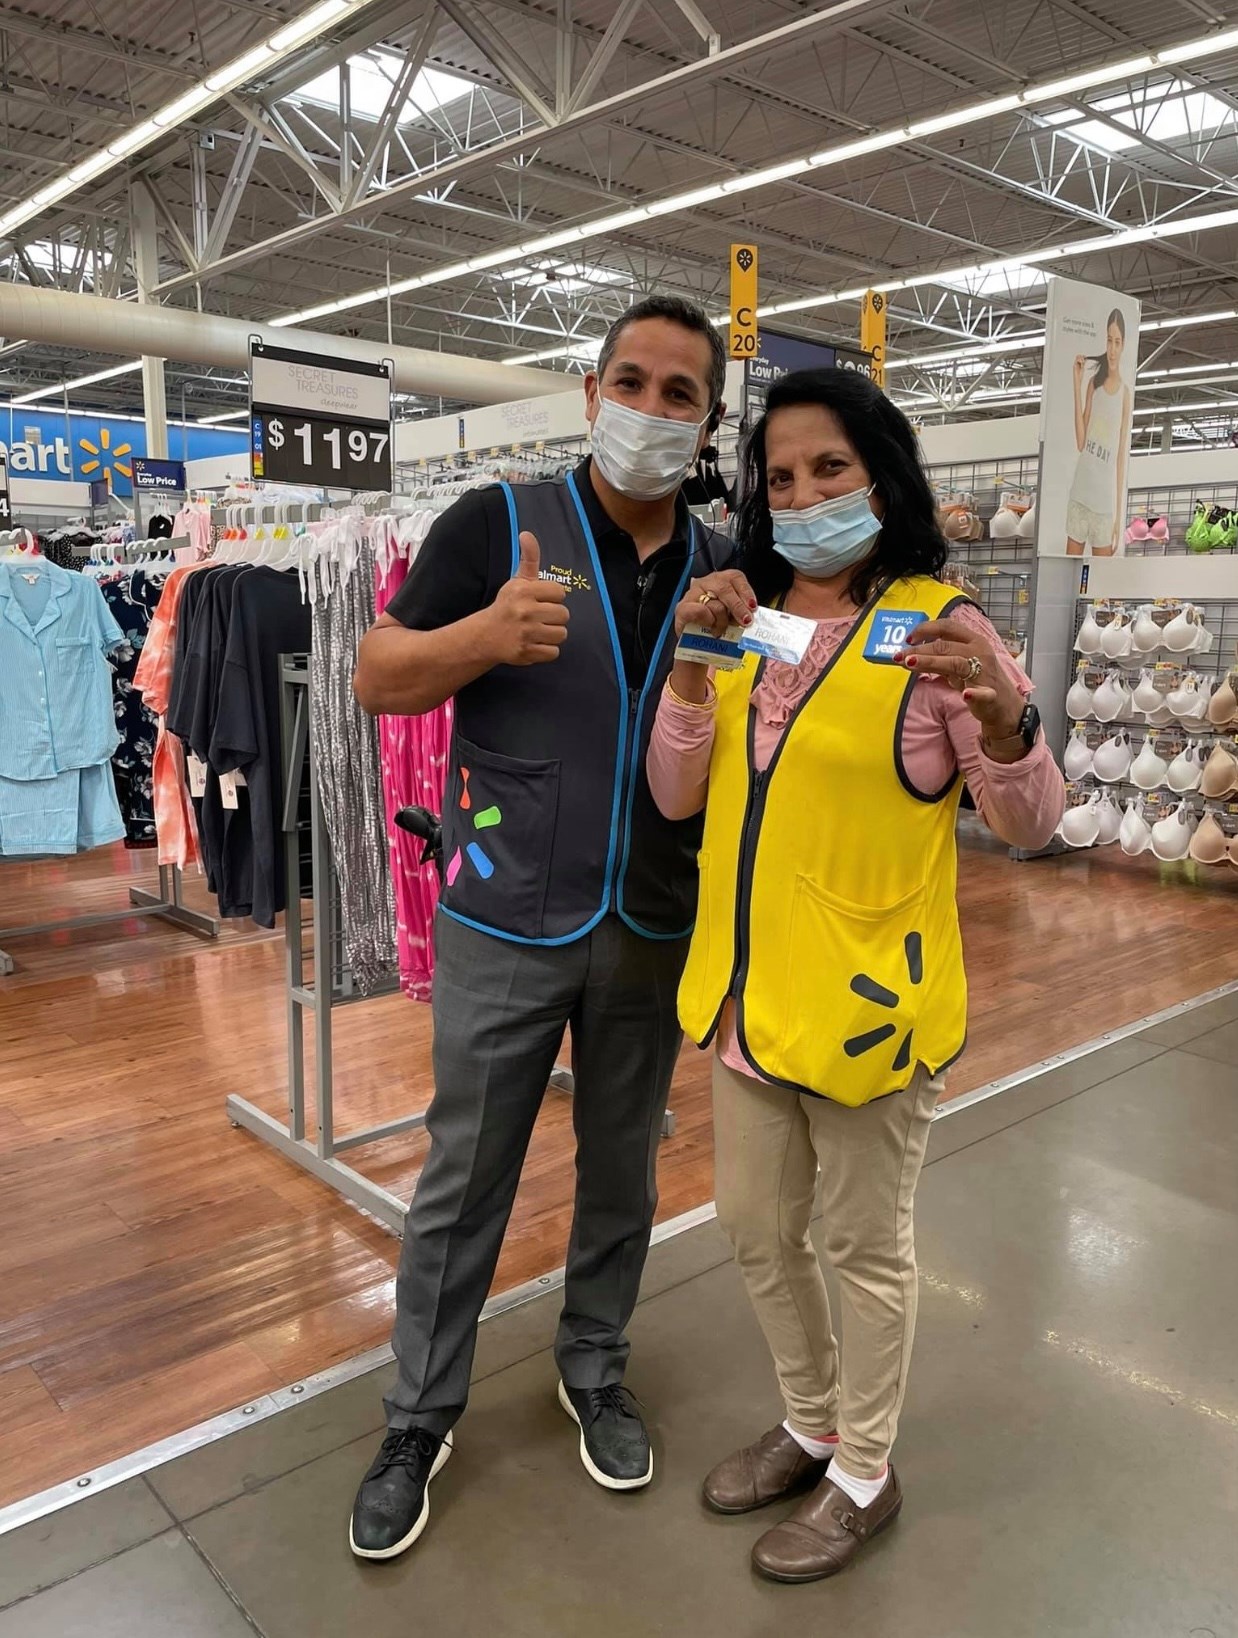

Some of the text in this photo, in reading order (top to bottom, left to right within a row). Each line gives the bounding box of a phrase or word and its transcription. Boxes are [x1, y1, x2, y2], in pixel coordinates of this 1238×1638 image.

[736, 307, 752, 327] C
[733, 334, 756, 352] 20
[872, 345, 882, 362] C
[288, 364, 336, 383] SECRET
[750, 361, 772, 379] Low
[872, 368, 882, 384] 21
[296, 379, 359, 399] TREASURES
[137, 474, 155, 484] Low
[155, 476, 177, 486] Price
[538, 570, 572, 585] almart
[550, 564, 572, 576] Proud
[883, 625, 907, 644] 10
